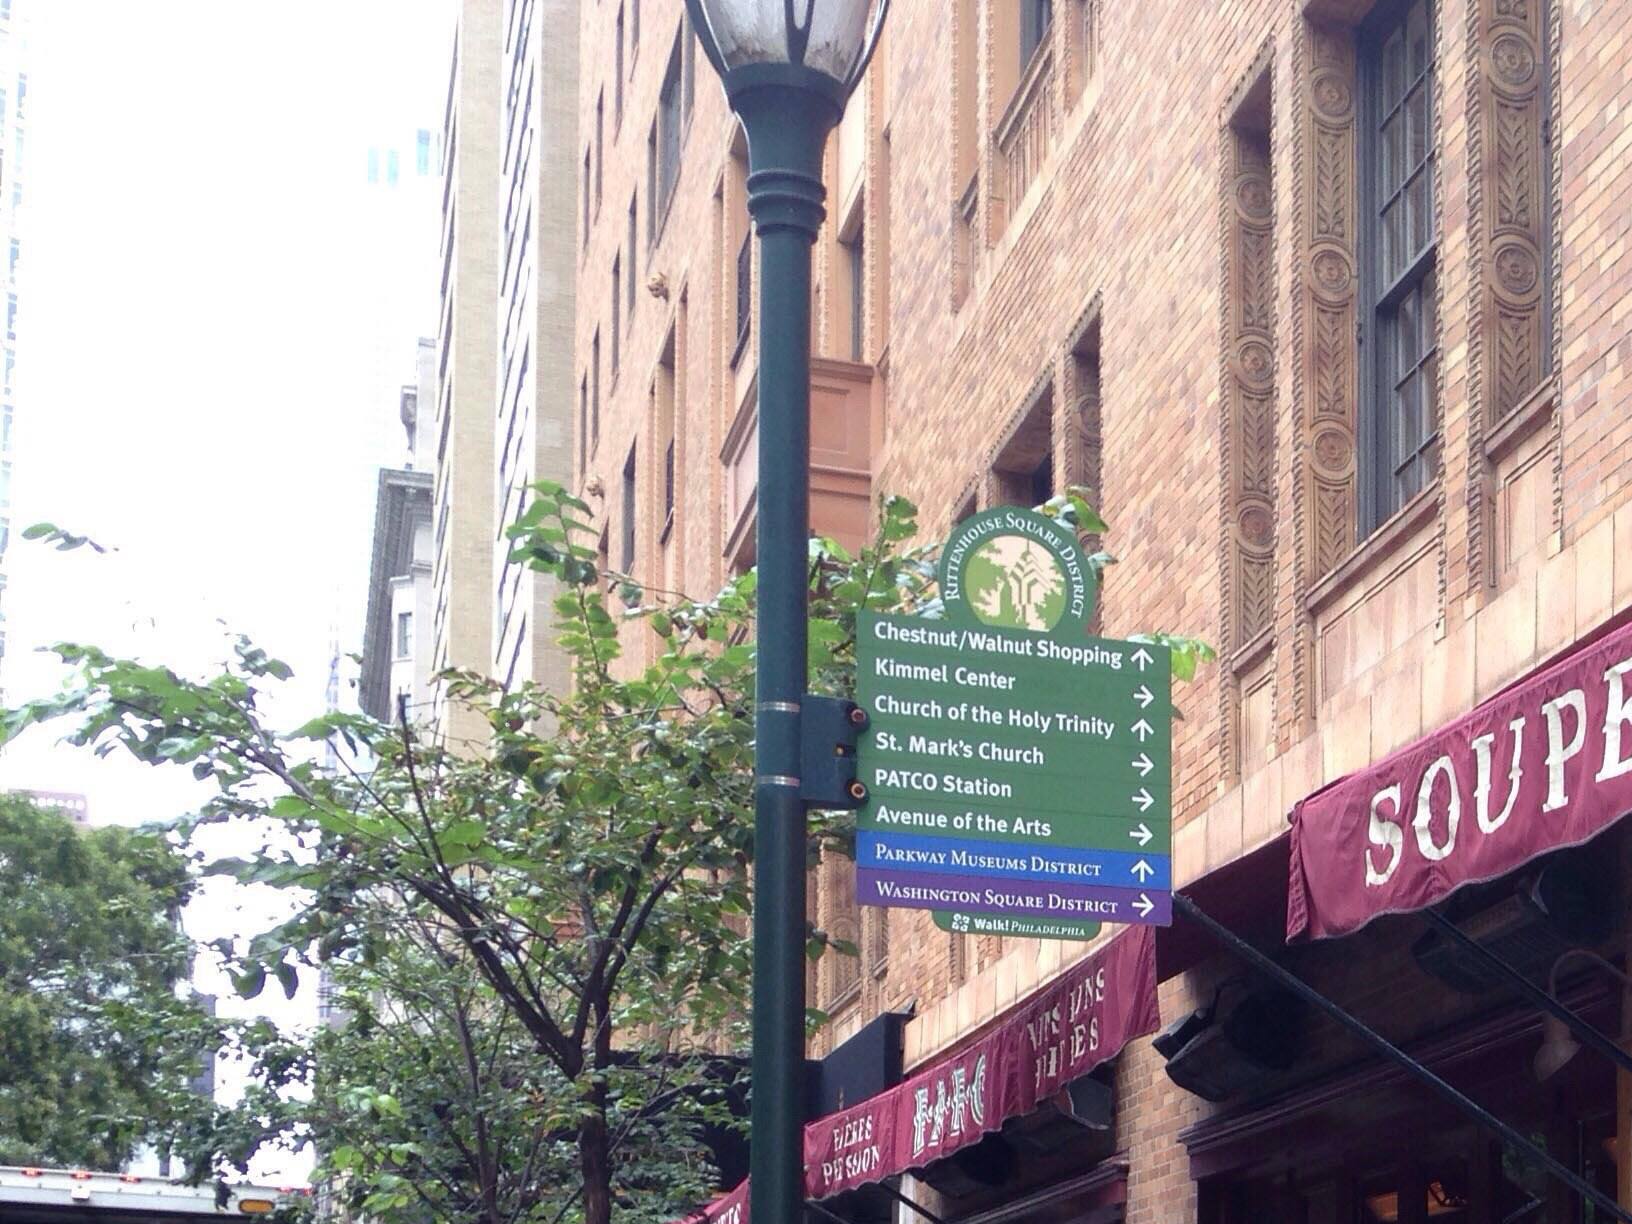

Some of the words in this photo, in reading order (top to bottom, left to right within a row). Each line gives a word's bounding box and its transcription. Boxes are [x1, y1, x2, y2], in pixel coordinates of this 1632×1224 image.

[945, 518, 1004, 600] RITTENHOUSE
[1006, 512, 1062, 549] SQUARE
[1059, 545, 1084, 618] DISTRICT
[874, 621, 1033, 657] Chestnut/Walnut
[1037, 638, 1123, 670] Shopping
[874, 658, 948, 684] Kimmel
[954, 667, 1016, 690] Center
[874, 695, 943, 720] Church
[947, 701, 970, 721] of
[972, 704, 1002, 725] the
[1008, 708, 1051, 733] Holy
[1056, 713, 1115, 740] Trinity
[875, 732, 902, 753] St.
[909, 735, 973, 759] Mark's
[978, 742, 1044, 765] Church
[874, 769, 938, 791] PATCO
[943, 775, 1012, 798] Station
[876, 805, 948, 828] Avenue
[952, 811, 973, 830] of
[975, 813, 1007, 833] the
[1013, 817, 1052, 837] Arts
[875, 844, 946, 864] PARKWAY
[951, 851, 1027, 871] MUSEUMS
[1031, 857, 1101, 876] DISTRICT
[876, 881, 980, 904] WASHINGTON
[985, 889, 1043, 909] SQUARE
[1048, 894, 1118, 914] DISTRICT
[974, 918, 1009, 931] Walk!
[1011, 921, 1085, 937] PHILADELPHIA
